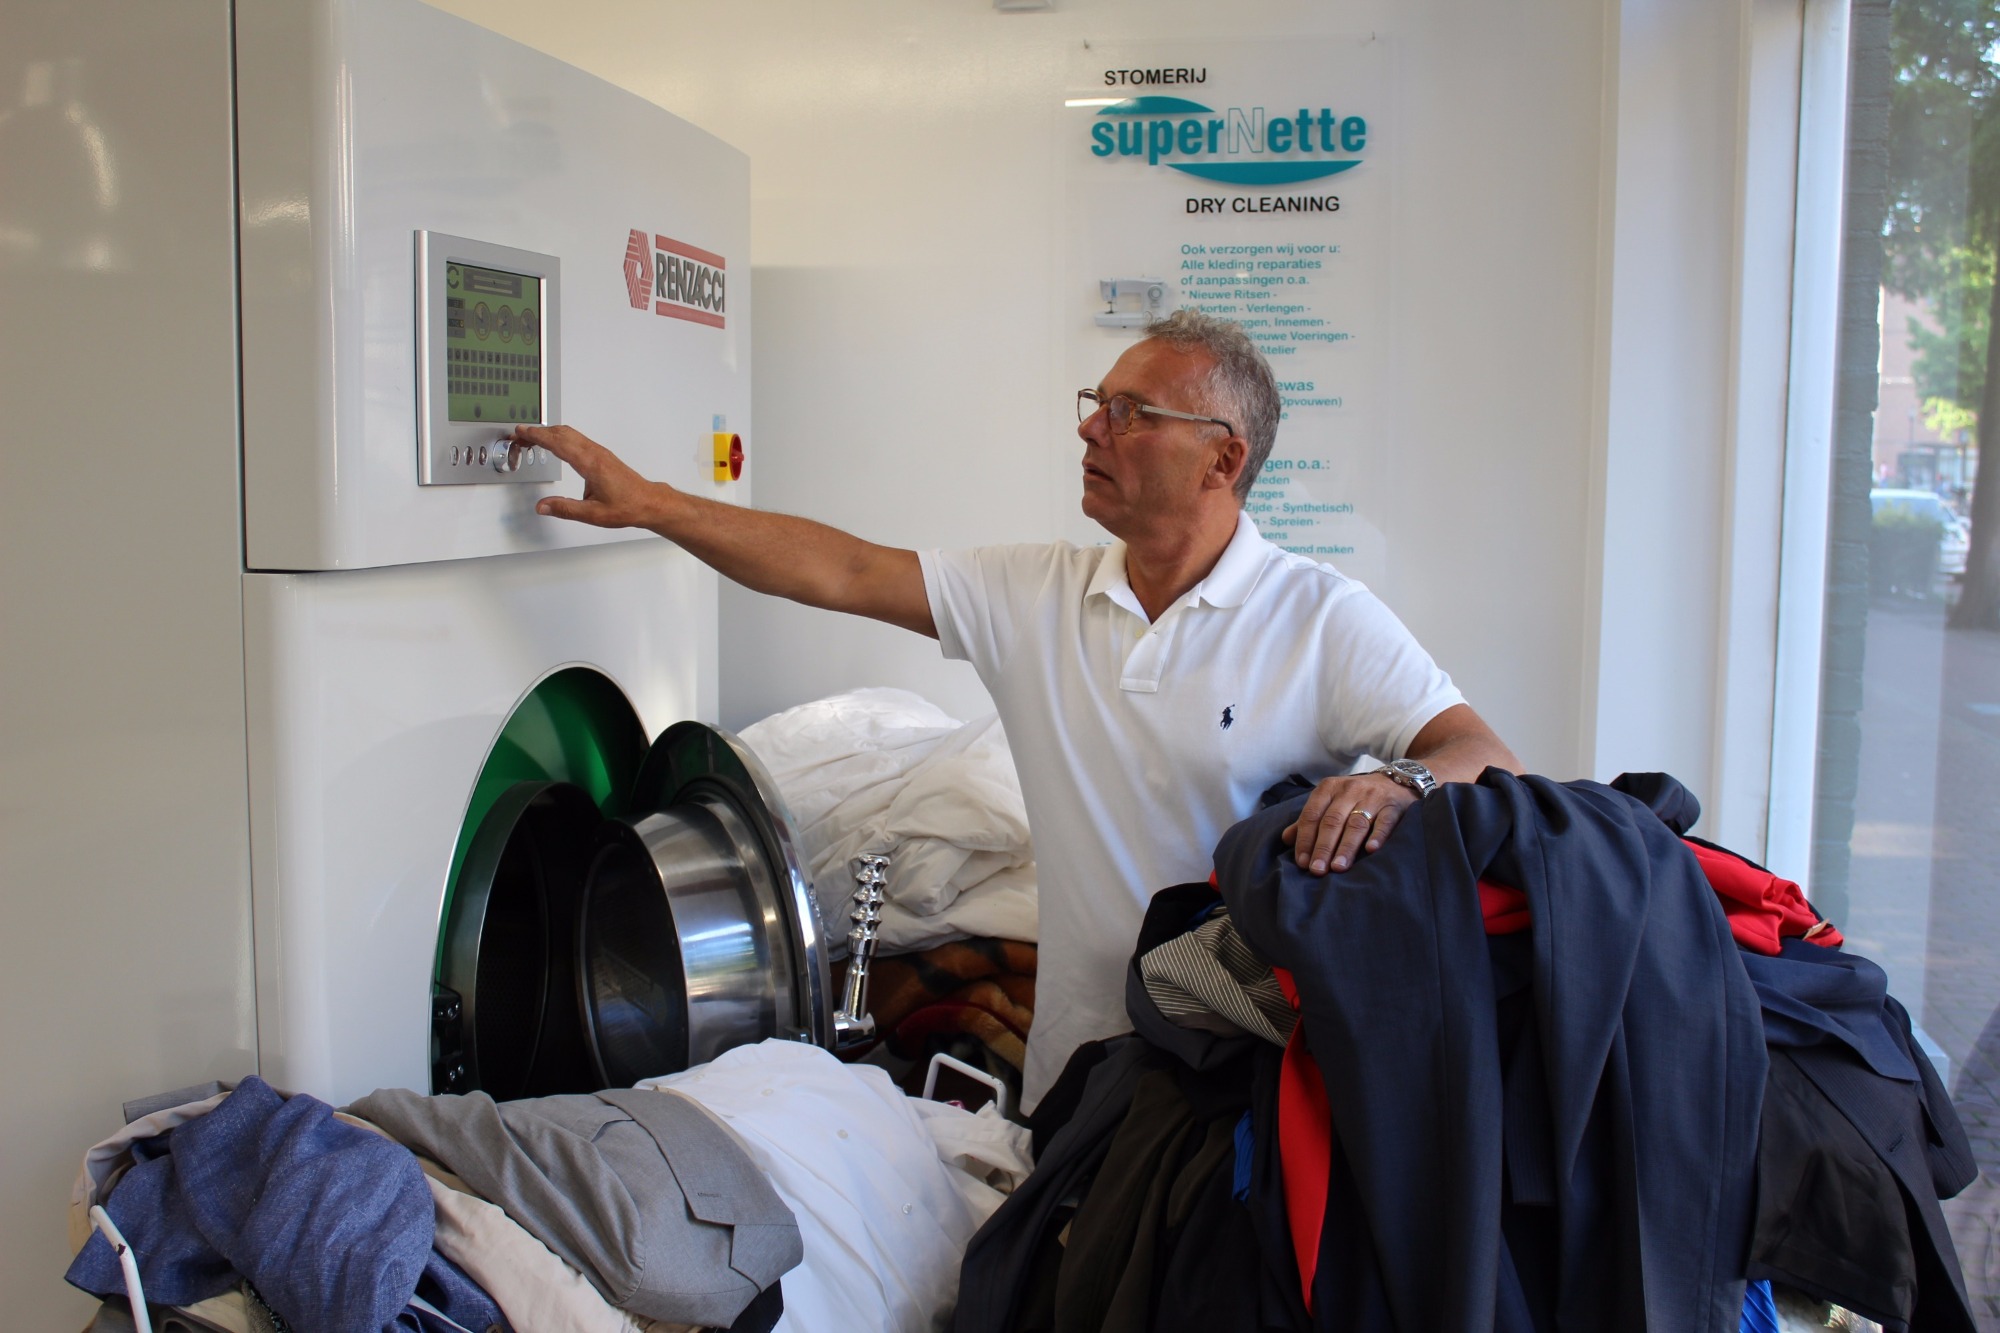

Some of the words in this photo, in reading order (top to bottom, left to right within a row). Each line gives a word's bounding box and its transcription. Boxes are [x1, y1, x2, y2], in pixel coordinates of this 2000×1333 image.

[1104, 68, 1207, 85] STOMERIJ
[1091, 107, 1367, 165] superNette
[1186, 198, 1226, 213] DRY
[1232, 196, 1340, 212] CLEANING
[1181, 244, 1206, 255] Ook
[1209, 245, 1273, 256] verzorgen
[1276, 244, 1294, 256] wij
[1297, 244, 1326, 254] voor
[1329, 244, 1341, 253] u:
[1181, 260, 1205, 270] Alle
[1208, 259, 1254, 271] kleding
[1257, 258, 1322, 271] reparaties
[656, 252, 725, 313] RENZACCI
[1181, 275, 1193, 285] of
[1196, 275, 1284, 287] aanpassingen
[1287, 275, 1309, 284] o.a.
[1189, 289, 1231, 299] Nieuwe
[1234, 289, 1270, 299] Ritsen
[1246, 303, 1304, 315] Verlengen
[1275, 317, 1324, 326] Innemen
[1290, 331, 1349, 342] Voeringen
[1282, 503, 1354, 514] Synthetisch)
[1270, 516, 1313, 527] Spreien
[1316, 544, 1354, 554] maken
